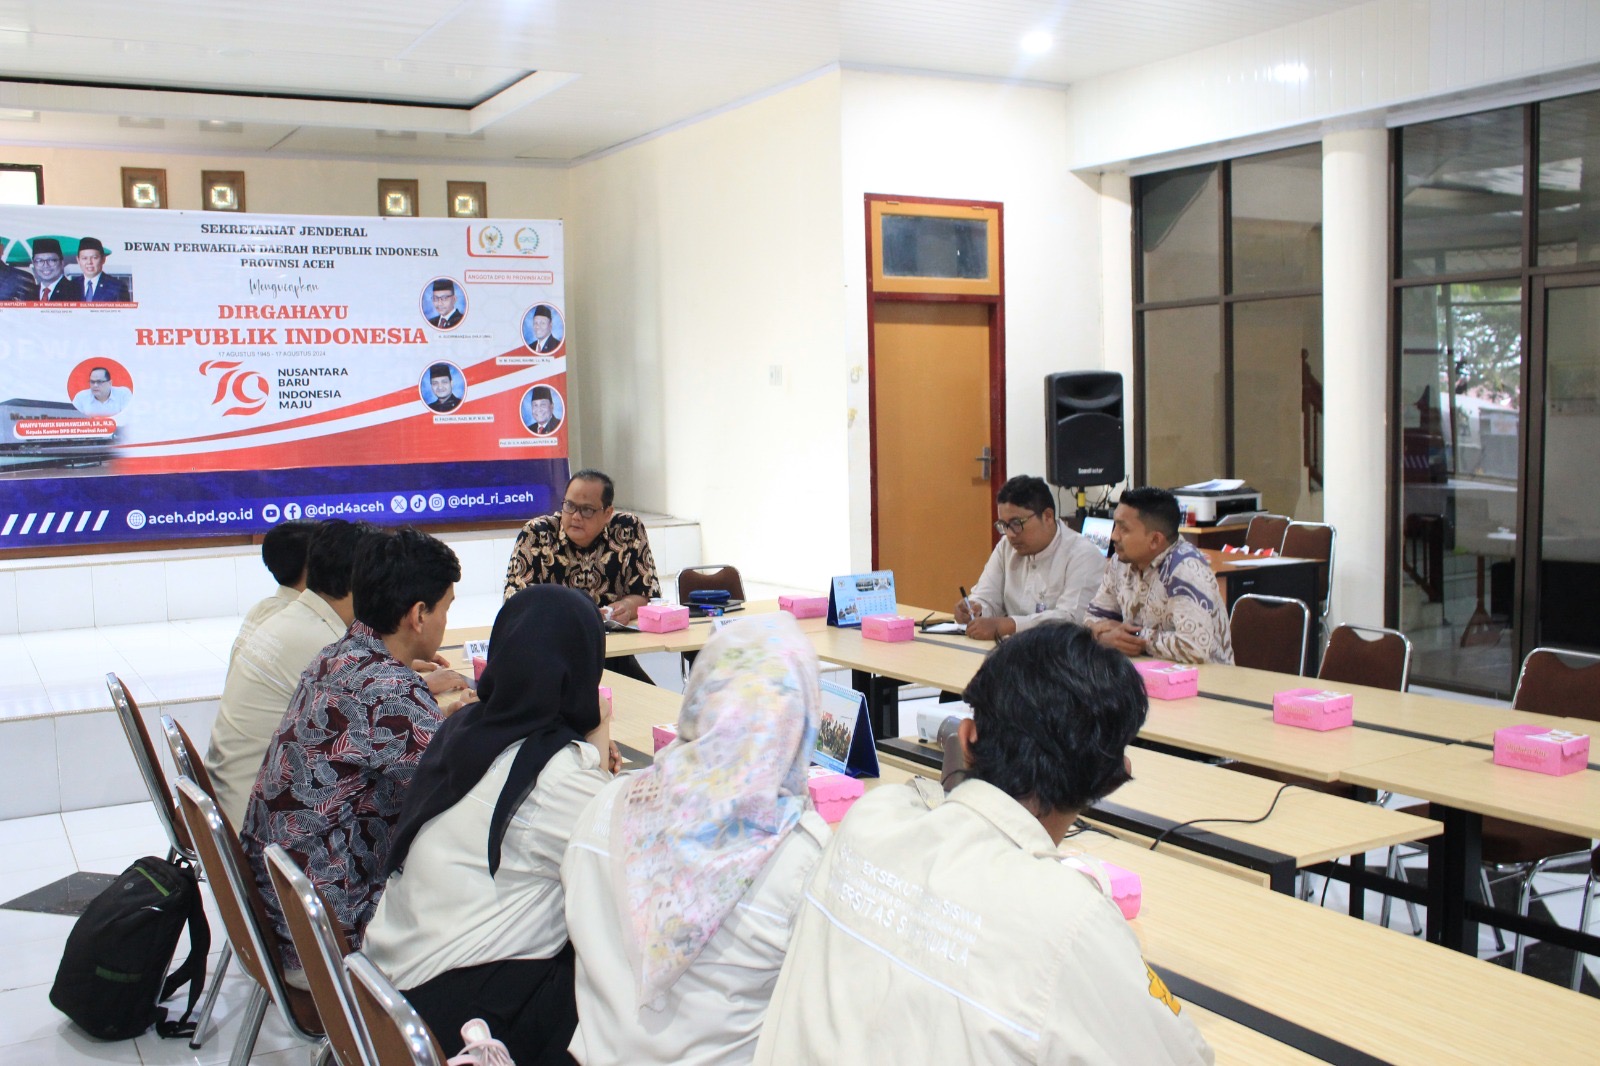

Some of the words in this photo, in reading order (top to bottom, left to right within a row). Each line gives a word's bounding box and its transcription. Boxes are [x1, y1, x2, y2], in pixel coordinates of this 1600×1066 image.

[200, 223, 296, 236] SEKRETARIAT
[299, 226, 368, 237] JENDERAL
[124, 241, 170, 252] DEWAN
[174, 243, 256, 253] PERWAKILAN
[259, 244, 308, 255] DAERAH
[312, 245, 372, 255] REPUBLIK
[375, 247, 439, 257] INDONESIA
[240, 258, 299, 268] PROVINSI
[302, 259, 335, 269] ACEH
[249, 276, 319, 299] Mengucapkan
[218, 304, 348, 320] DIRGAHAYU
[135, 328, 278, 346] REPUBLIK
[285, 327, 428, 345] INDONESIA
[277, 367, 348, 377] NUSANTARA
[278, 377, 310, 387] BARU
[278, 389, 342, 399] INDONESIA
[279, 400, 312, 410] MAJU
[448, 491, 534, 509] @dpd_ri_aceh
[149, 508, 253, 525] aceh.dpd.go.id
[304, 500, 385, 518] @dpd4aceh
